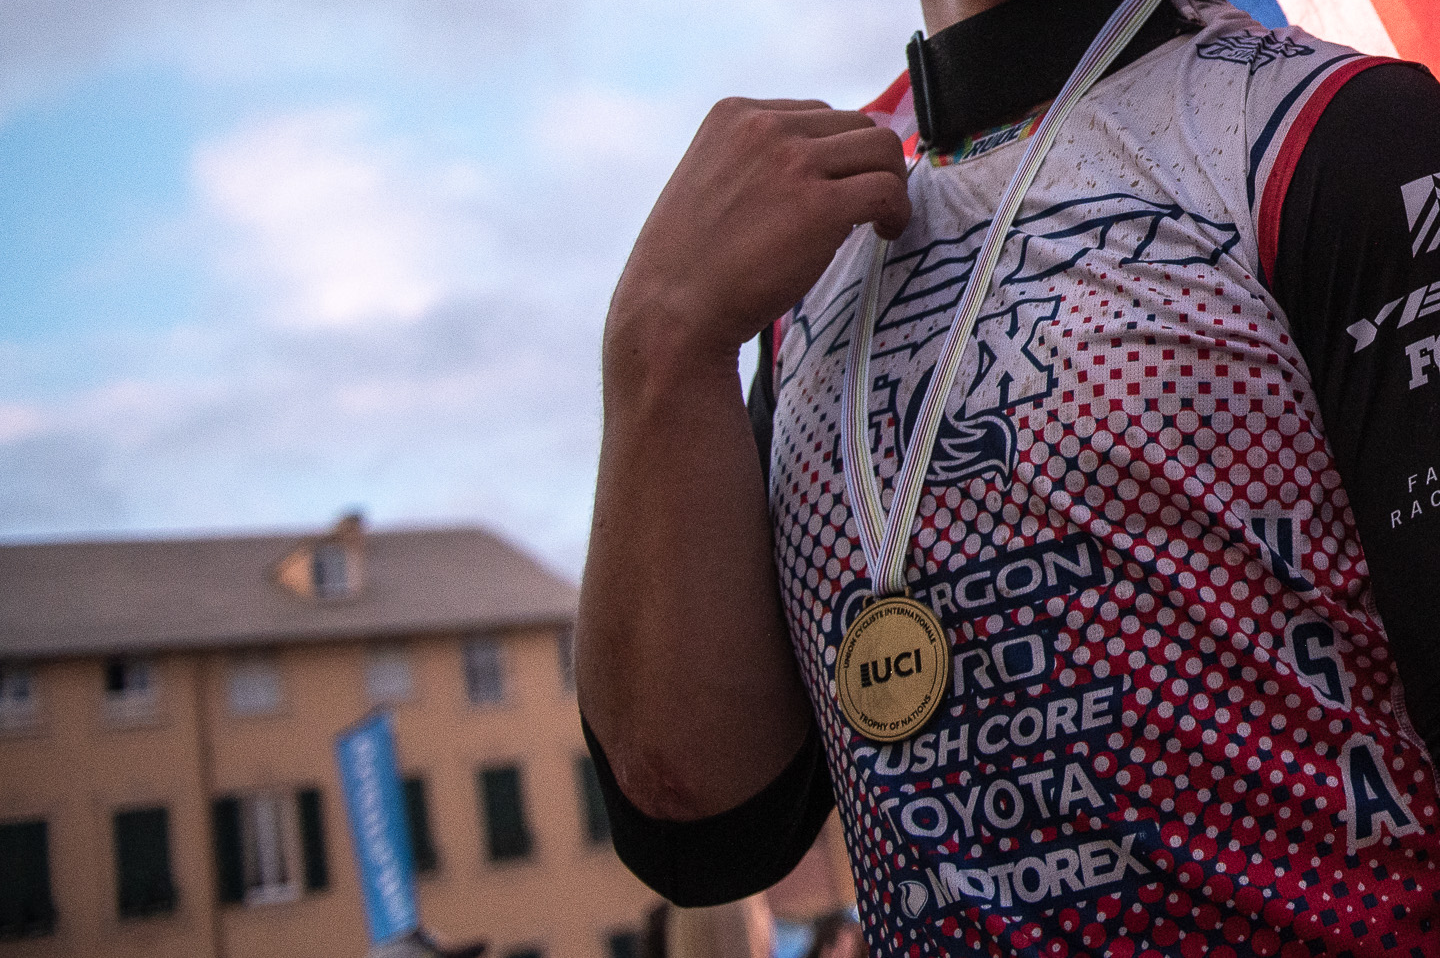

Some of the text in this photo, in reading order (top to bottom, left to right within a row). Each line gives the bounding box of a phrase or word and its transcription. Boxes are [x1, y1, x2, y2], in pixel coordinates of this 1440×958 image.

[914, 542, 1093, 619] RGON
[844, 607, 937, 669] UNION CYCLISTE INTERNATIONALE
[872, 648, 922, 684] UCI
[953, 632, 1047, 698] RO
[859, 694, 932, 732] TROPHY OF NATIONS
[879, 761, 1106, 845] TOYOTA
[925, 832, 1150, 909] MOTOREX
